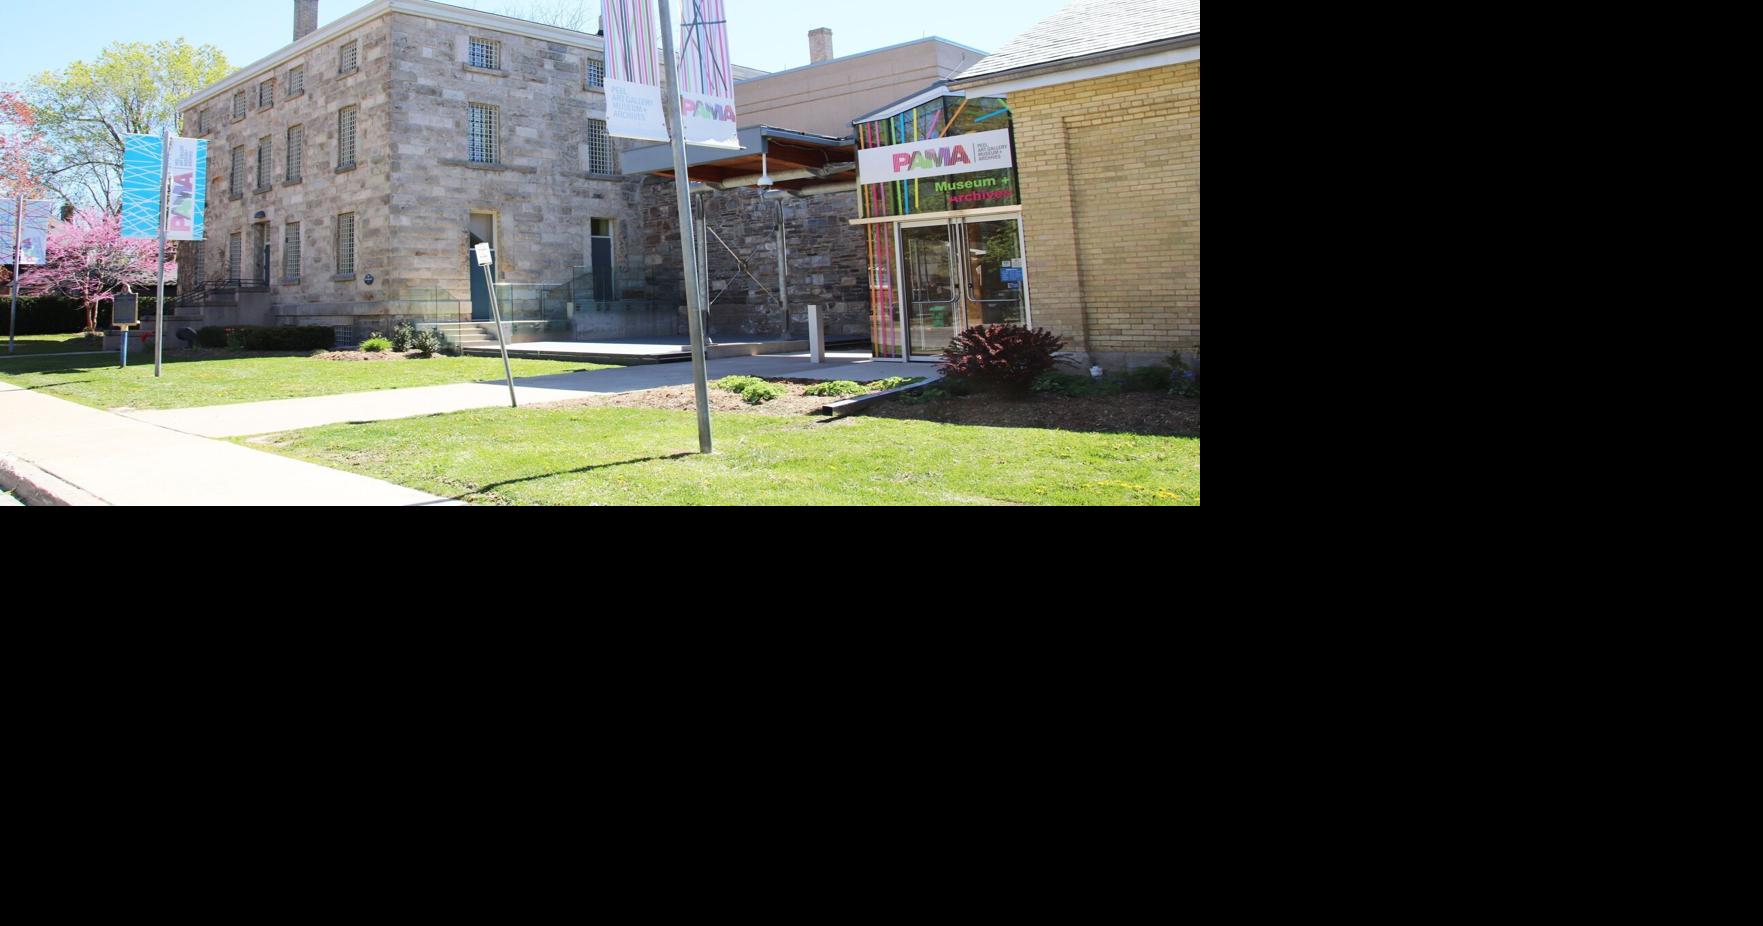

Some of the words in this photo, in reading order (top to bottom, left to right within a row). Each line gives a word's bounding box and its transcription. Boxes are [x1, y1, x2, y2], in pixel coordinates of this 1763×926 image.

[682, 98, 736, 122] PAMA
[892, 145, 971, 172] PAMA
[935, 178, 996, 192] Museum
[170, 171, 193, 231] PAMA
